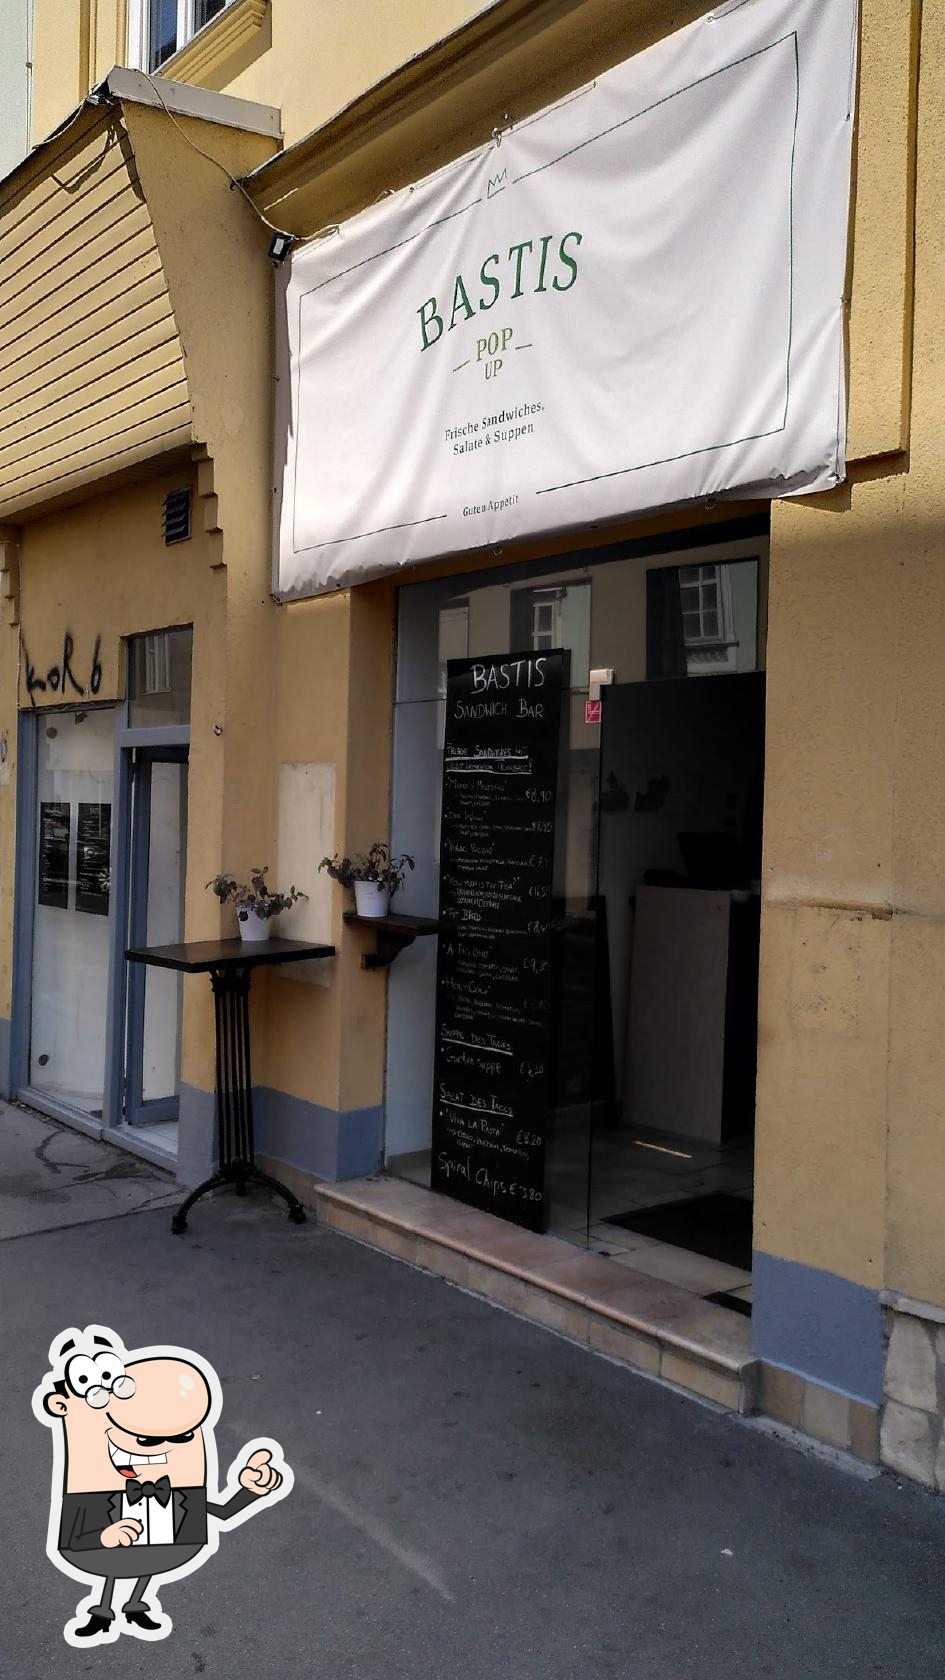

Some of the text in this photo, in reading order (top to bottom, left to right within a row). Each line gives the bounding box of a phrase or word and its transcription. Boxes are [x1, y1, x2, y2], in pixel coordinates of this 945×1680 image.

[416, 231, 583, 352] BASTIS
[476, 327, 514, 362] POP
[484, 359, 503, 381] UP
[445, 401, 545, 441] Frische Sandwiches,
[453, 423, 534, 456] Salate & Suppen
[462, 494, 520, 517] Guten Appetit
[470, 657, 547, 695] BASTIS
[454, 698, 544, 719] SANDWICH BAR
[438, 1151, 471, 1181] Spiral
[475, 1167, 507, 1198] Chips
